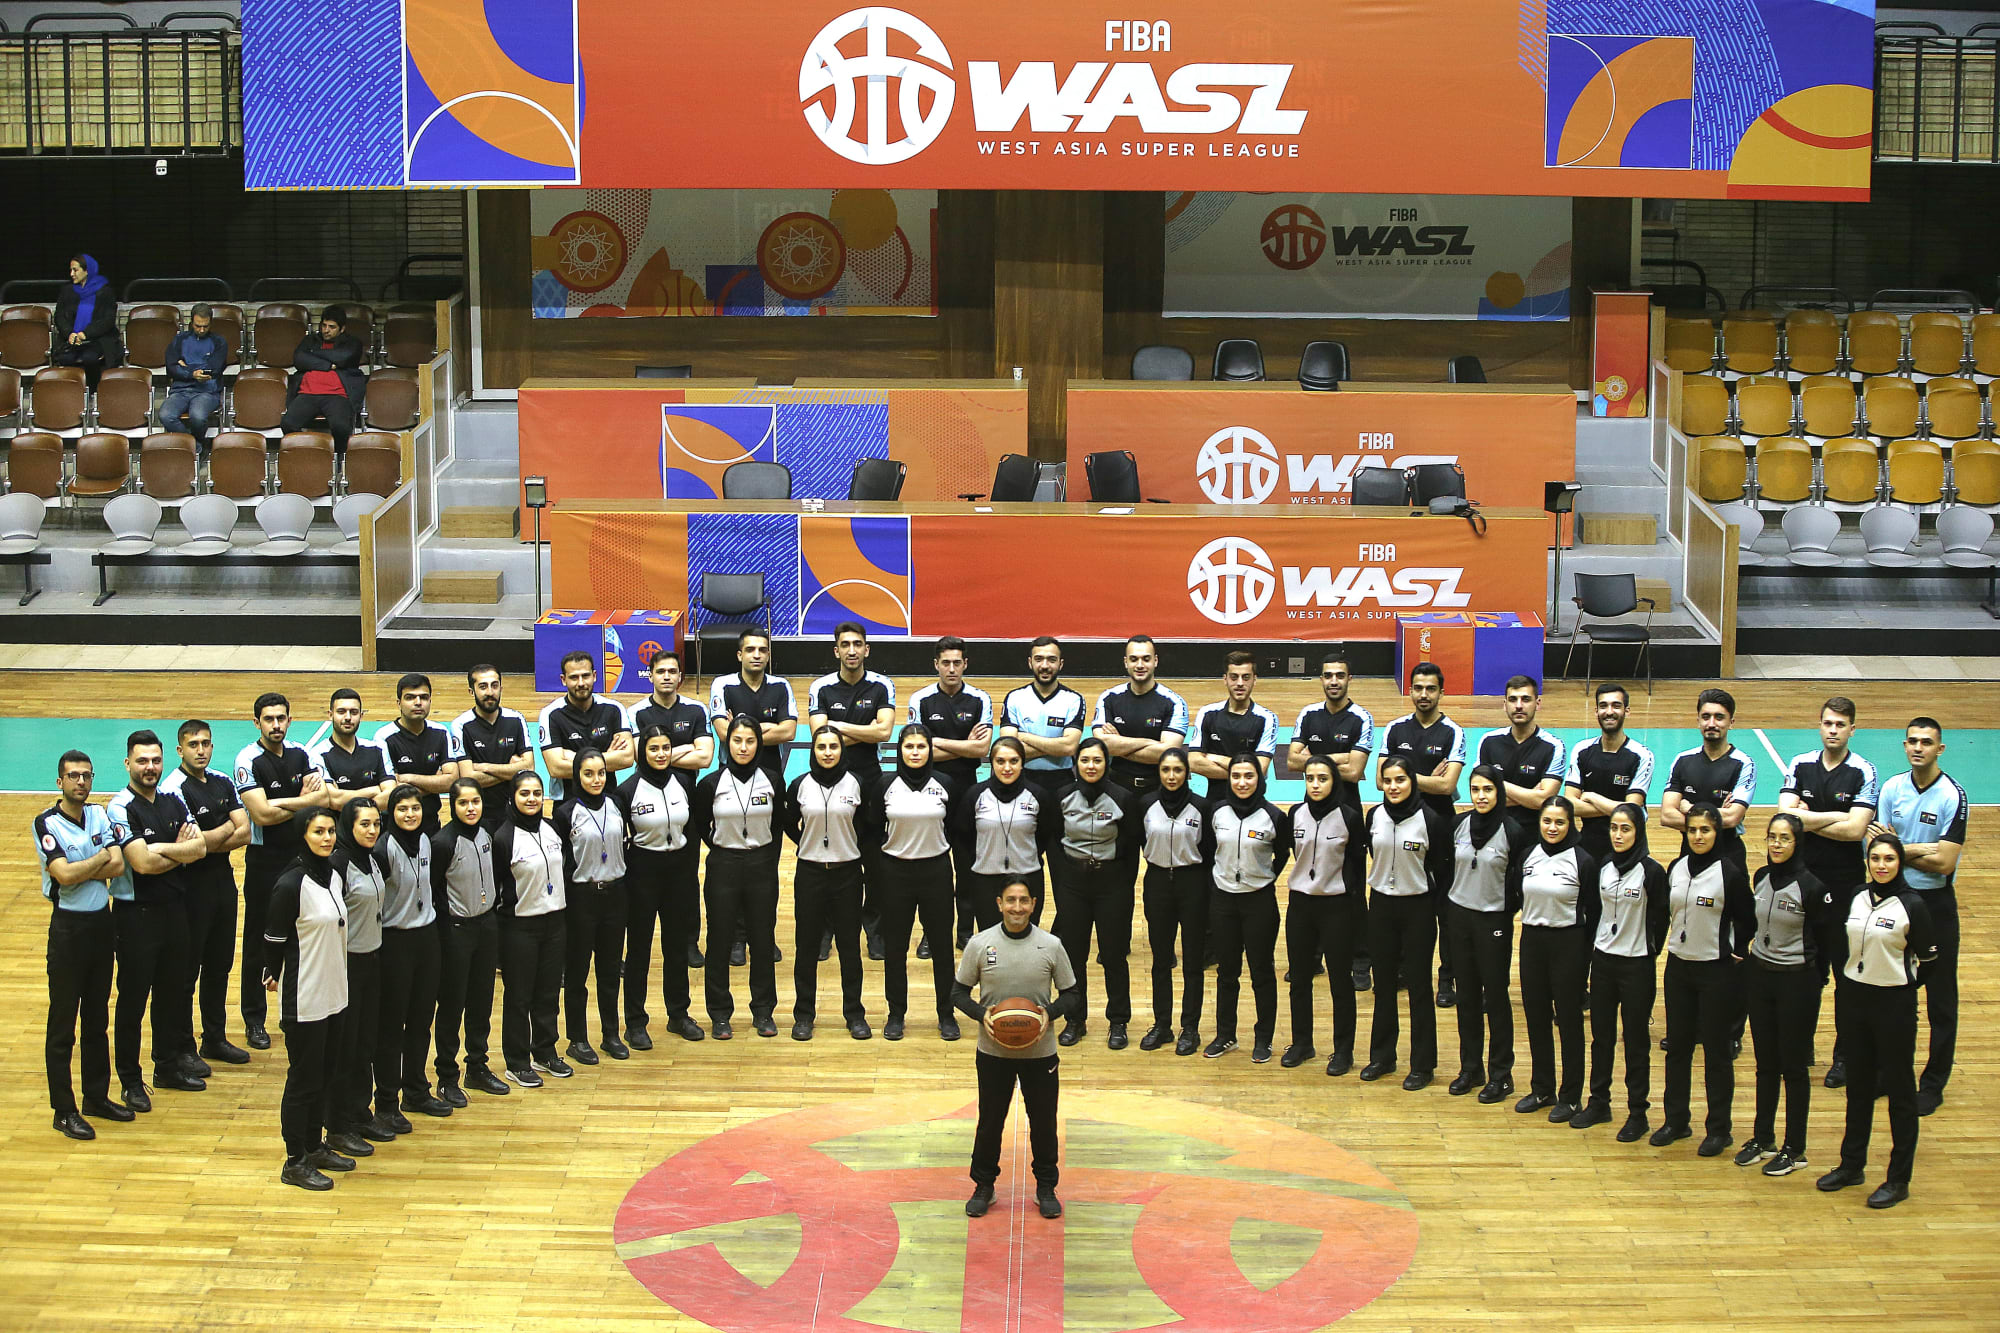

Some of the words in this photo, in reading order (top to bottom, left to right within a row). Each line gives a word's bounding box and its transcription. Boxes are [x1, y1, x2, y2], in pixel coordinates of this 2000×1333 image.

[1105, 20, 1171, 52] FIBA
[977, 141, 1041, 155] WEST
[1053, 141, 1108, 156] ASIA
[1121, 142, 1195, 157] SUPER
[1208, 143, 1300, 158] LEAGUE
[1389, 208, 1418, 222] FIBA
[1358, 432, 1394, 450] FIBA
[1290, 496, 1325, 505] WEST
[1330, 496, 1352, 505] ASI
[1358, 543, 1397, 562] FIBA
[1286, 611, 1323, 619] WEST
[1329, 611, 1360, 619] ASIA
